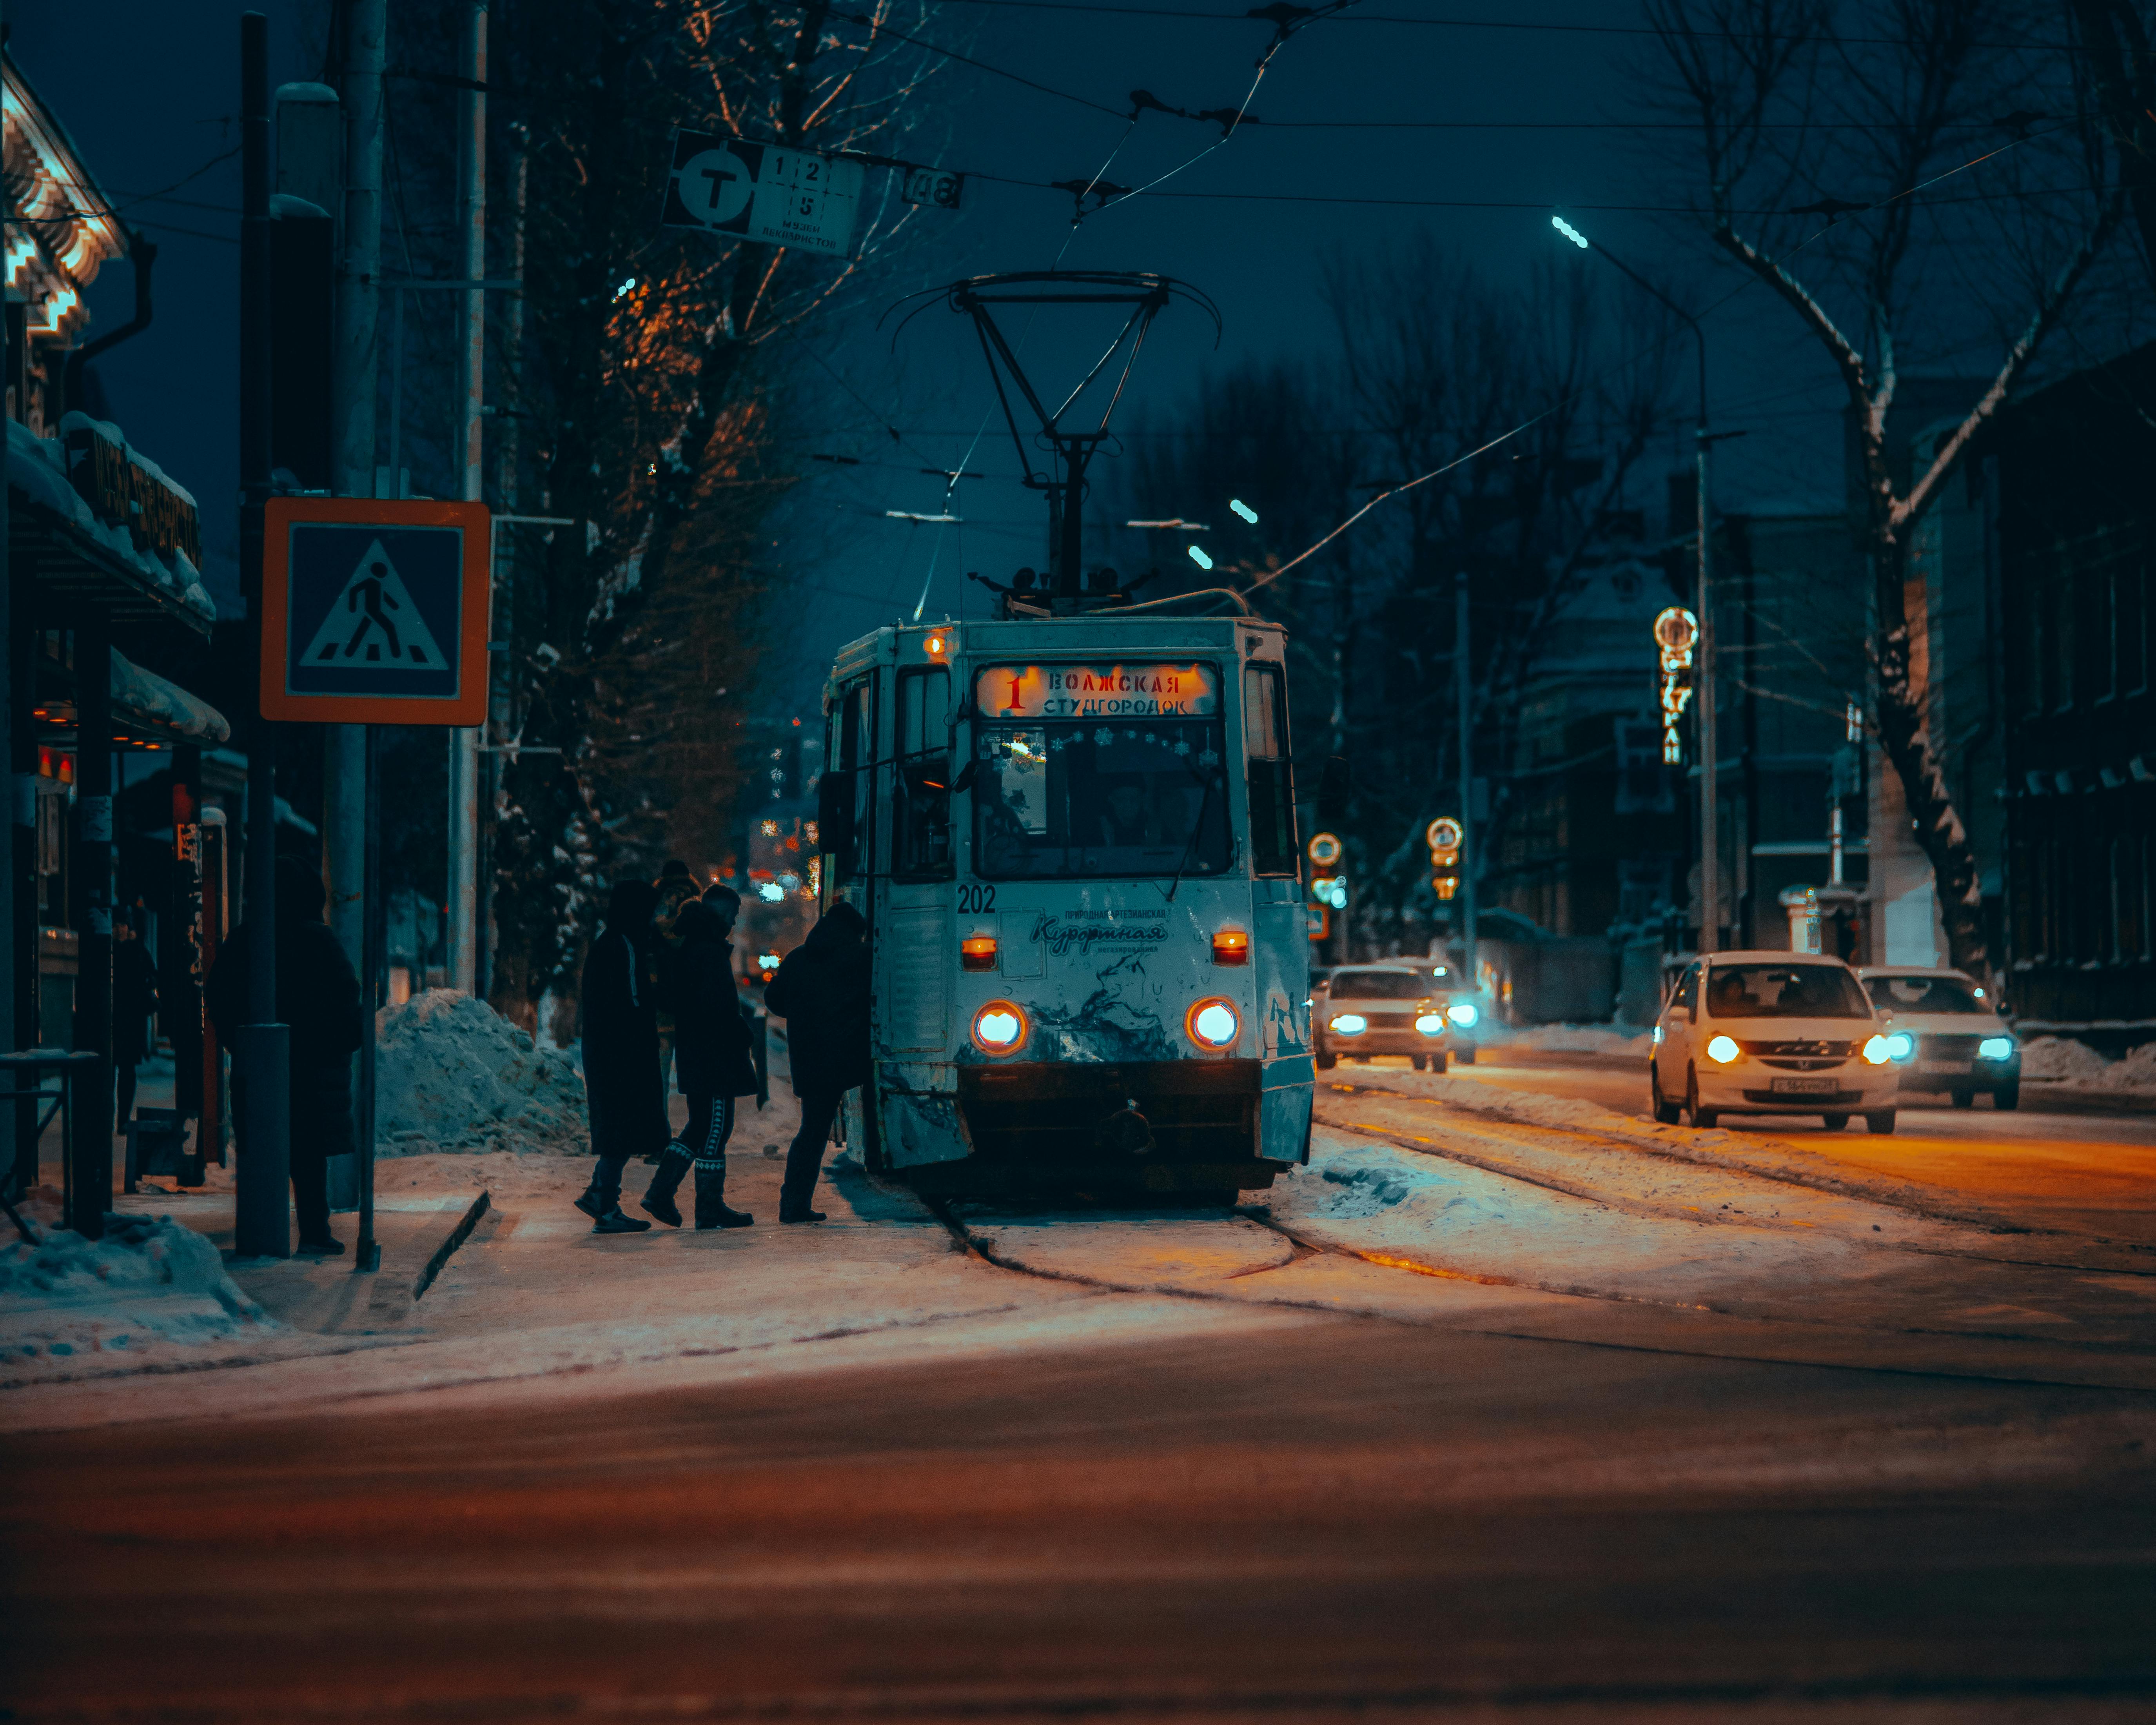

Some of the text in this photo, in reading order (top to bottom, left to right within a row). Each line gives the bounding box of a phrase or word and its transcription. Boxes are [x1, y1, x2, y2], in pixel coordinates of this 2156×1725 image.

[776, 156, 819, 181] 1 2
[800, 196, 814, 215] 5
[1007, 675, 1026, 710] 1
[1049, 673, 1179, 693] ВОЛЖСКАЯ
[1044, 698, 1188, 715] СТУДГОРОДОК
[957, 884, 996, 914] 202
[1065, 909, 1166, 919] ПРИРОДНАЯ АРТЕЗИАНСКАЯ
[1031, 916, 1167, 954] Курортная
